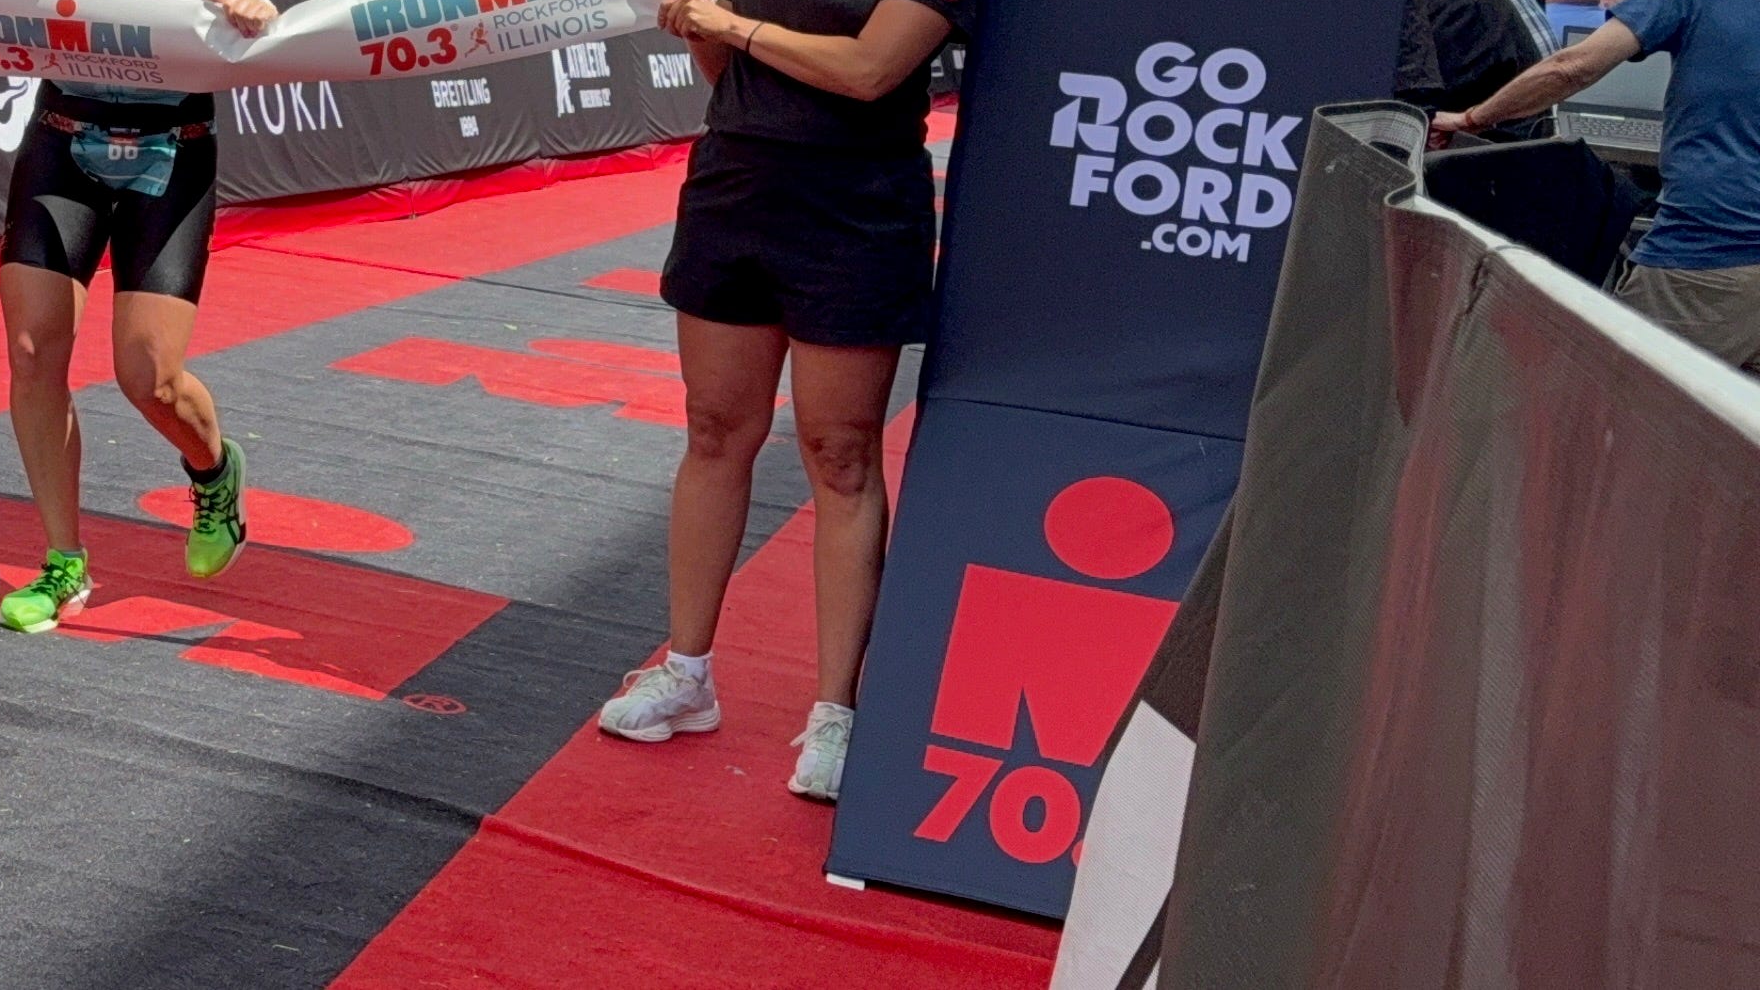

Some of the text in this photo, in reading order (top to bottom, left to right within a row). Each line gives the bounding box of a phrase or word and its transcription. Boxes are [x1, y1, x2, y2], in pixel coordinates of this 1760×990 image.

[360, 27, 457, 76] 70.3
[497, 11, 609, 52] ILLINOIS
[62, 52, 158, 70] ROCKFORD
[67, 63, 164, 84] ILLINOIS
[648, 53, 694, 89] ROUVY
[1135, 41, 1266, 104] GO
[431, 77, 492, 108] BREITLING
[1049, 71, 1303, 172] ROCK
[1070, 154, 1293, 229] FORD
[1141, 222, 1251, 263] .COM
